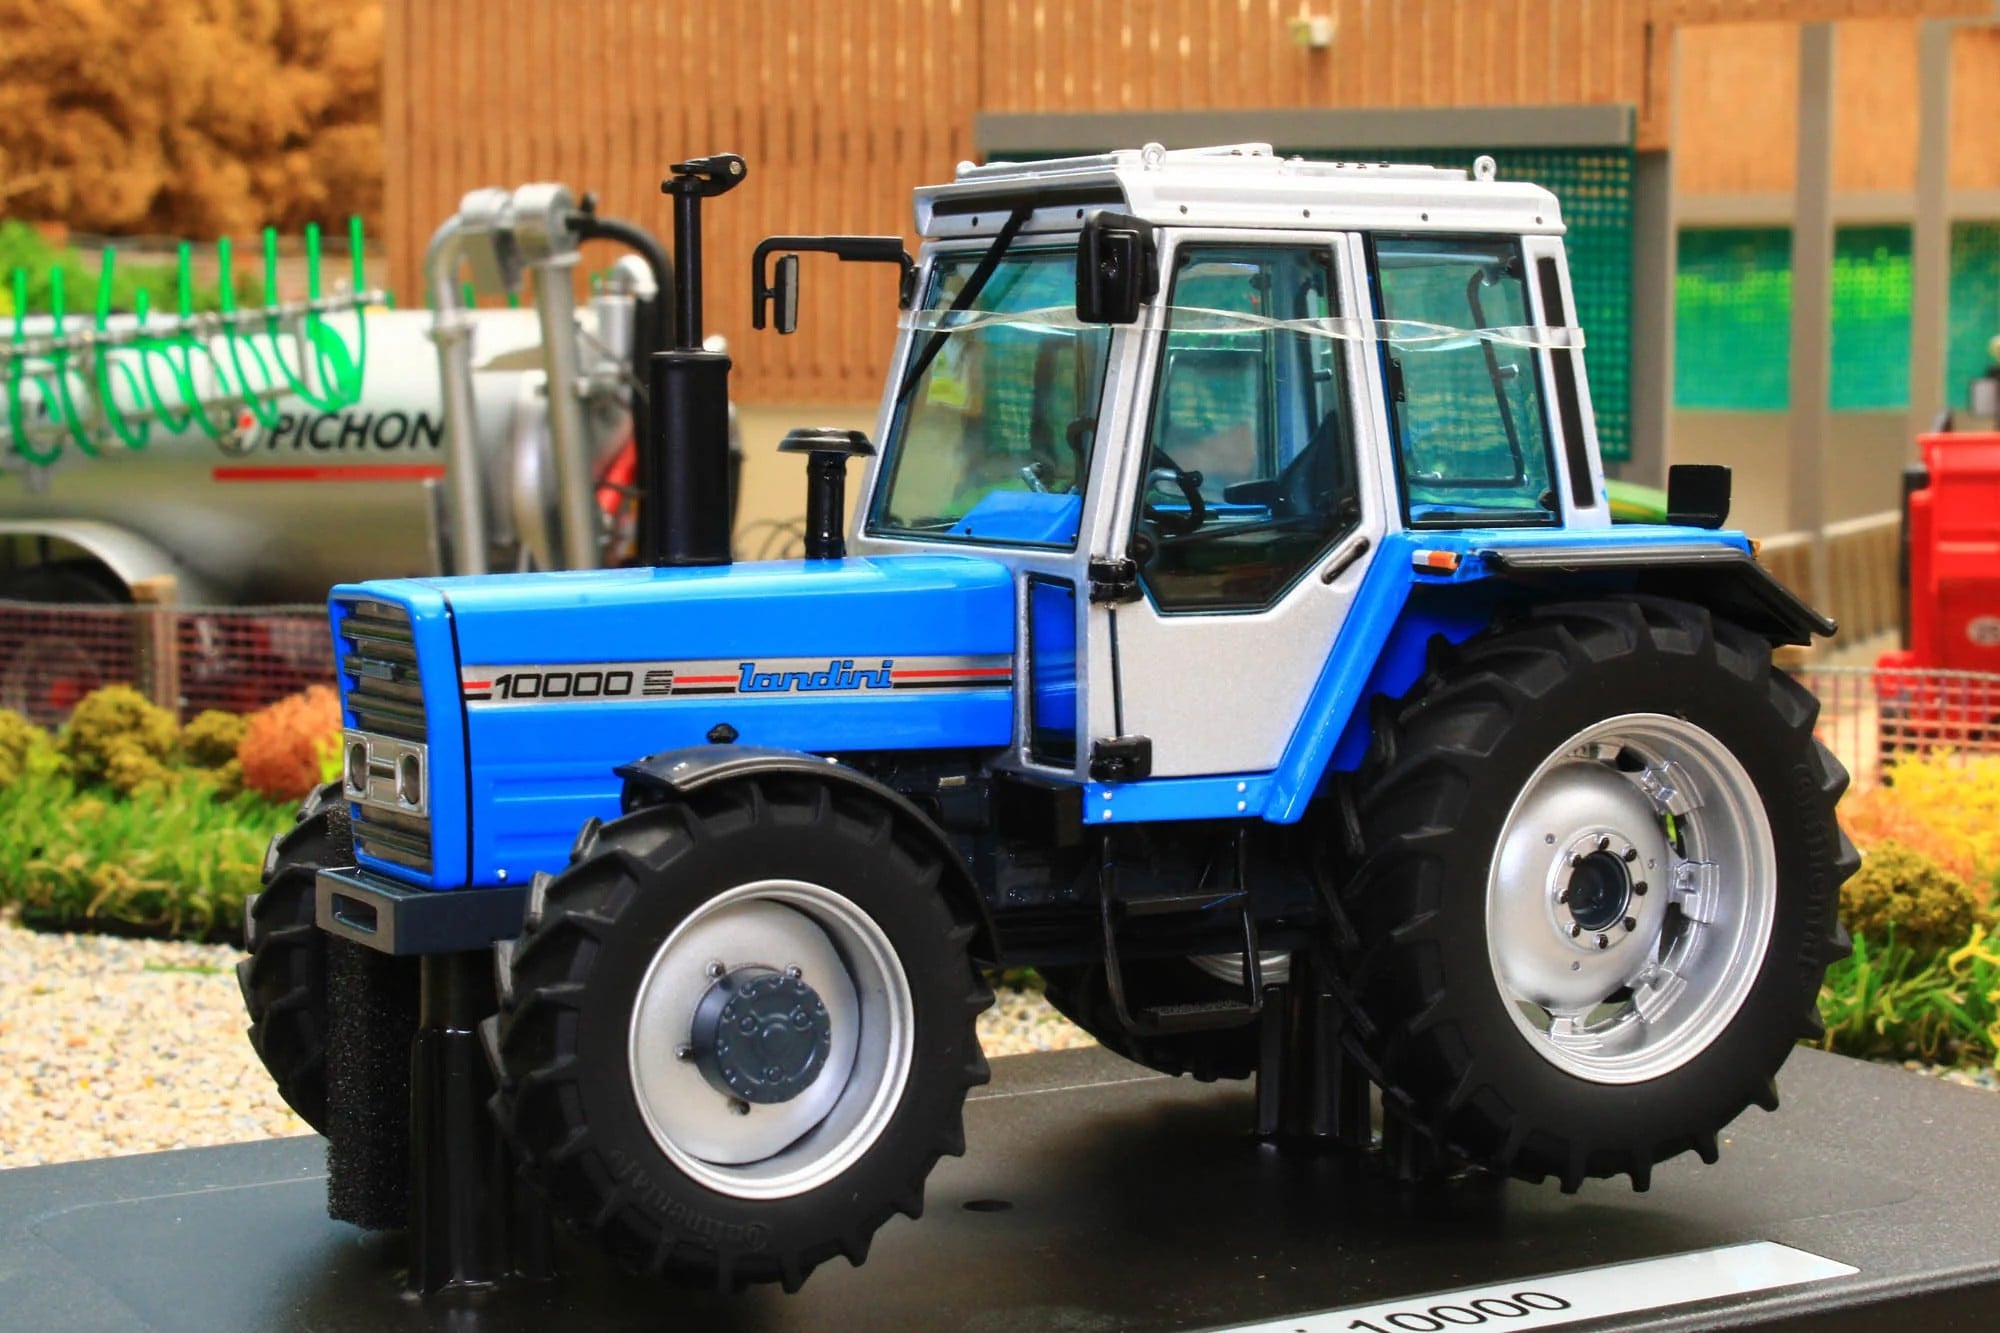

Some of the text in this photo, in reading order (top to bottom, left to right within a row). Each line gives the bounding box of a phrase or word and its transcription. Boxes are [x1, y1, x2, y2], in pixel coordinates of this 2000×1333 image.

[267, 411, 444, 450] PICHON
[495, 671, 633, 699] 10000
[642, 670, 673, 695] S
[1347, 1292, 1571, 1333] 10000
